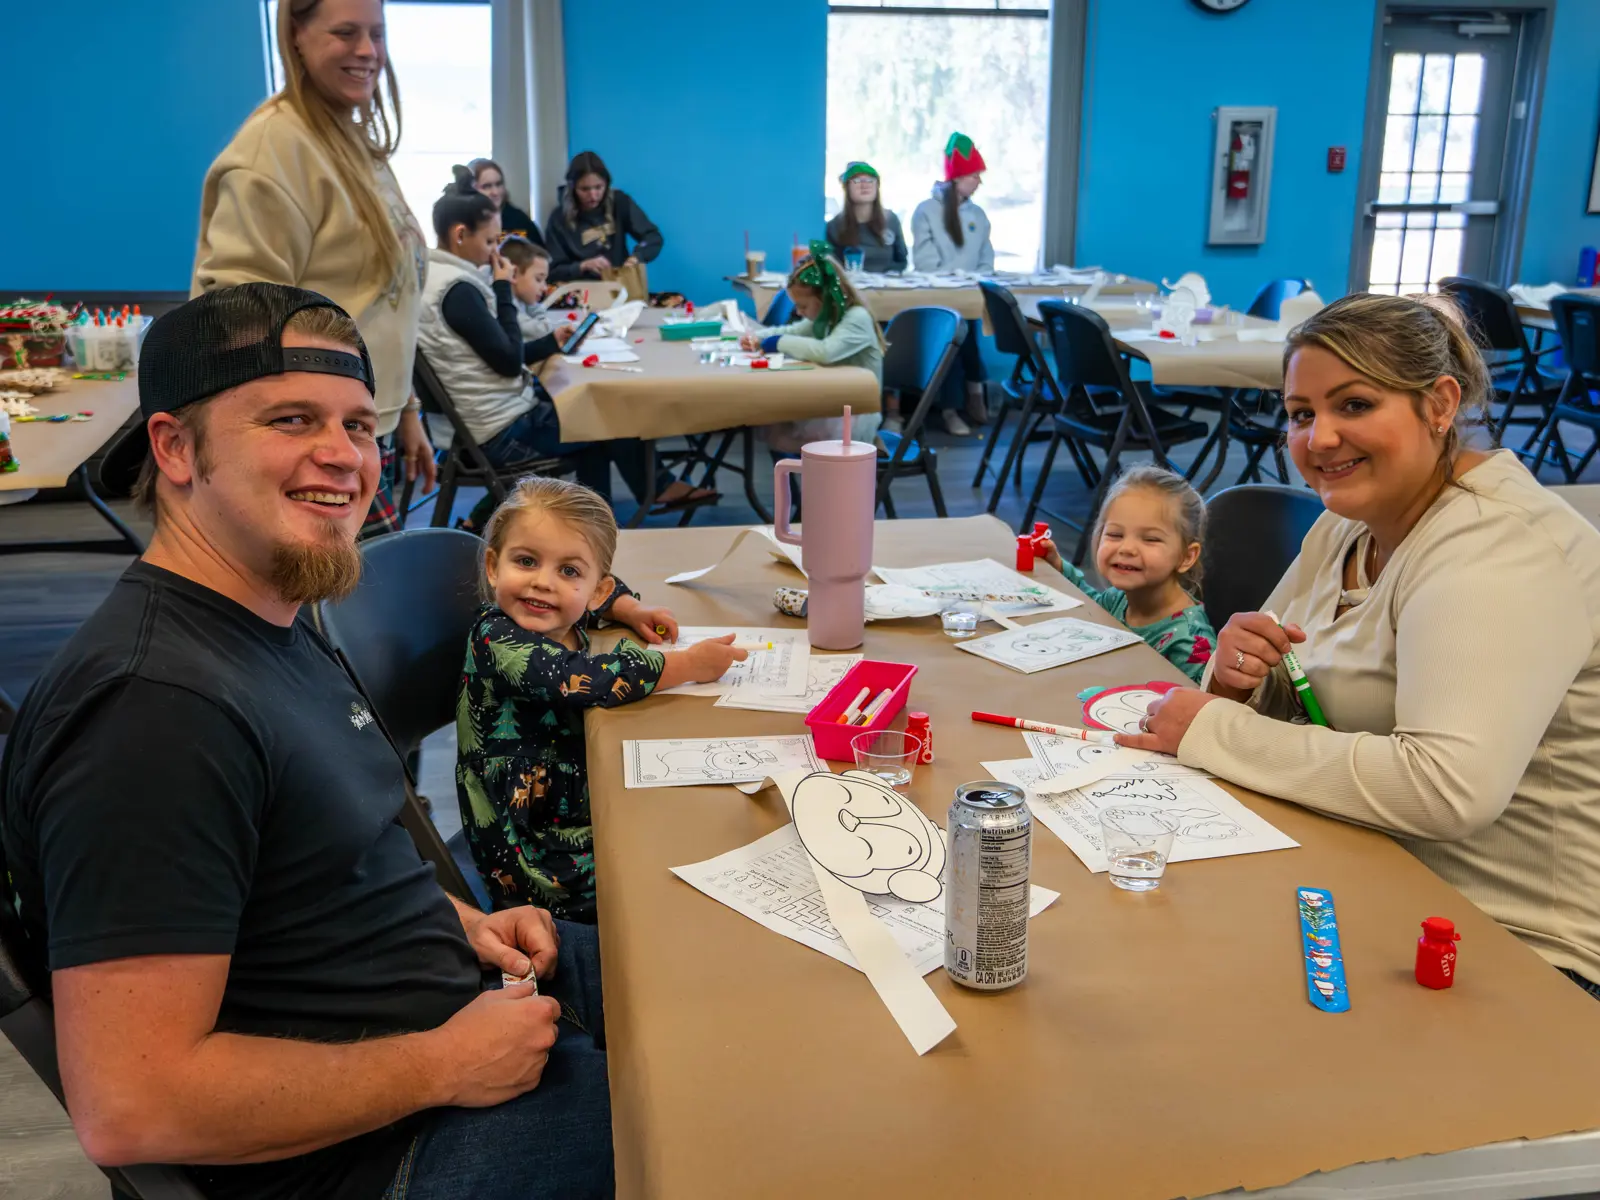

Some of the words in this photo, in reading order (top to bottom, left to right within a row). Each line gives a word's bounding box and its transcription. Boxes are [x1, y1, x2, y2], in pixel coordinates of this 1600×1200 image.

[981, 827, 1015, 835] Nutrition
[975, 970, 984, 984] CA
[984, 971, 997, 984] CRV
